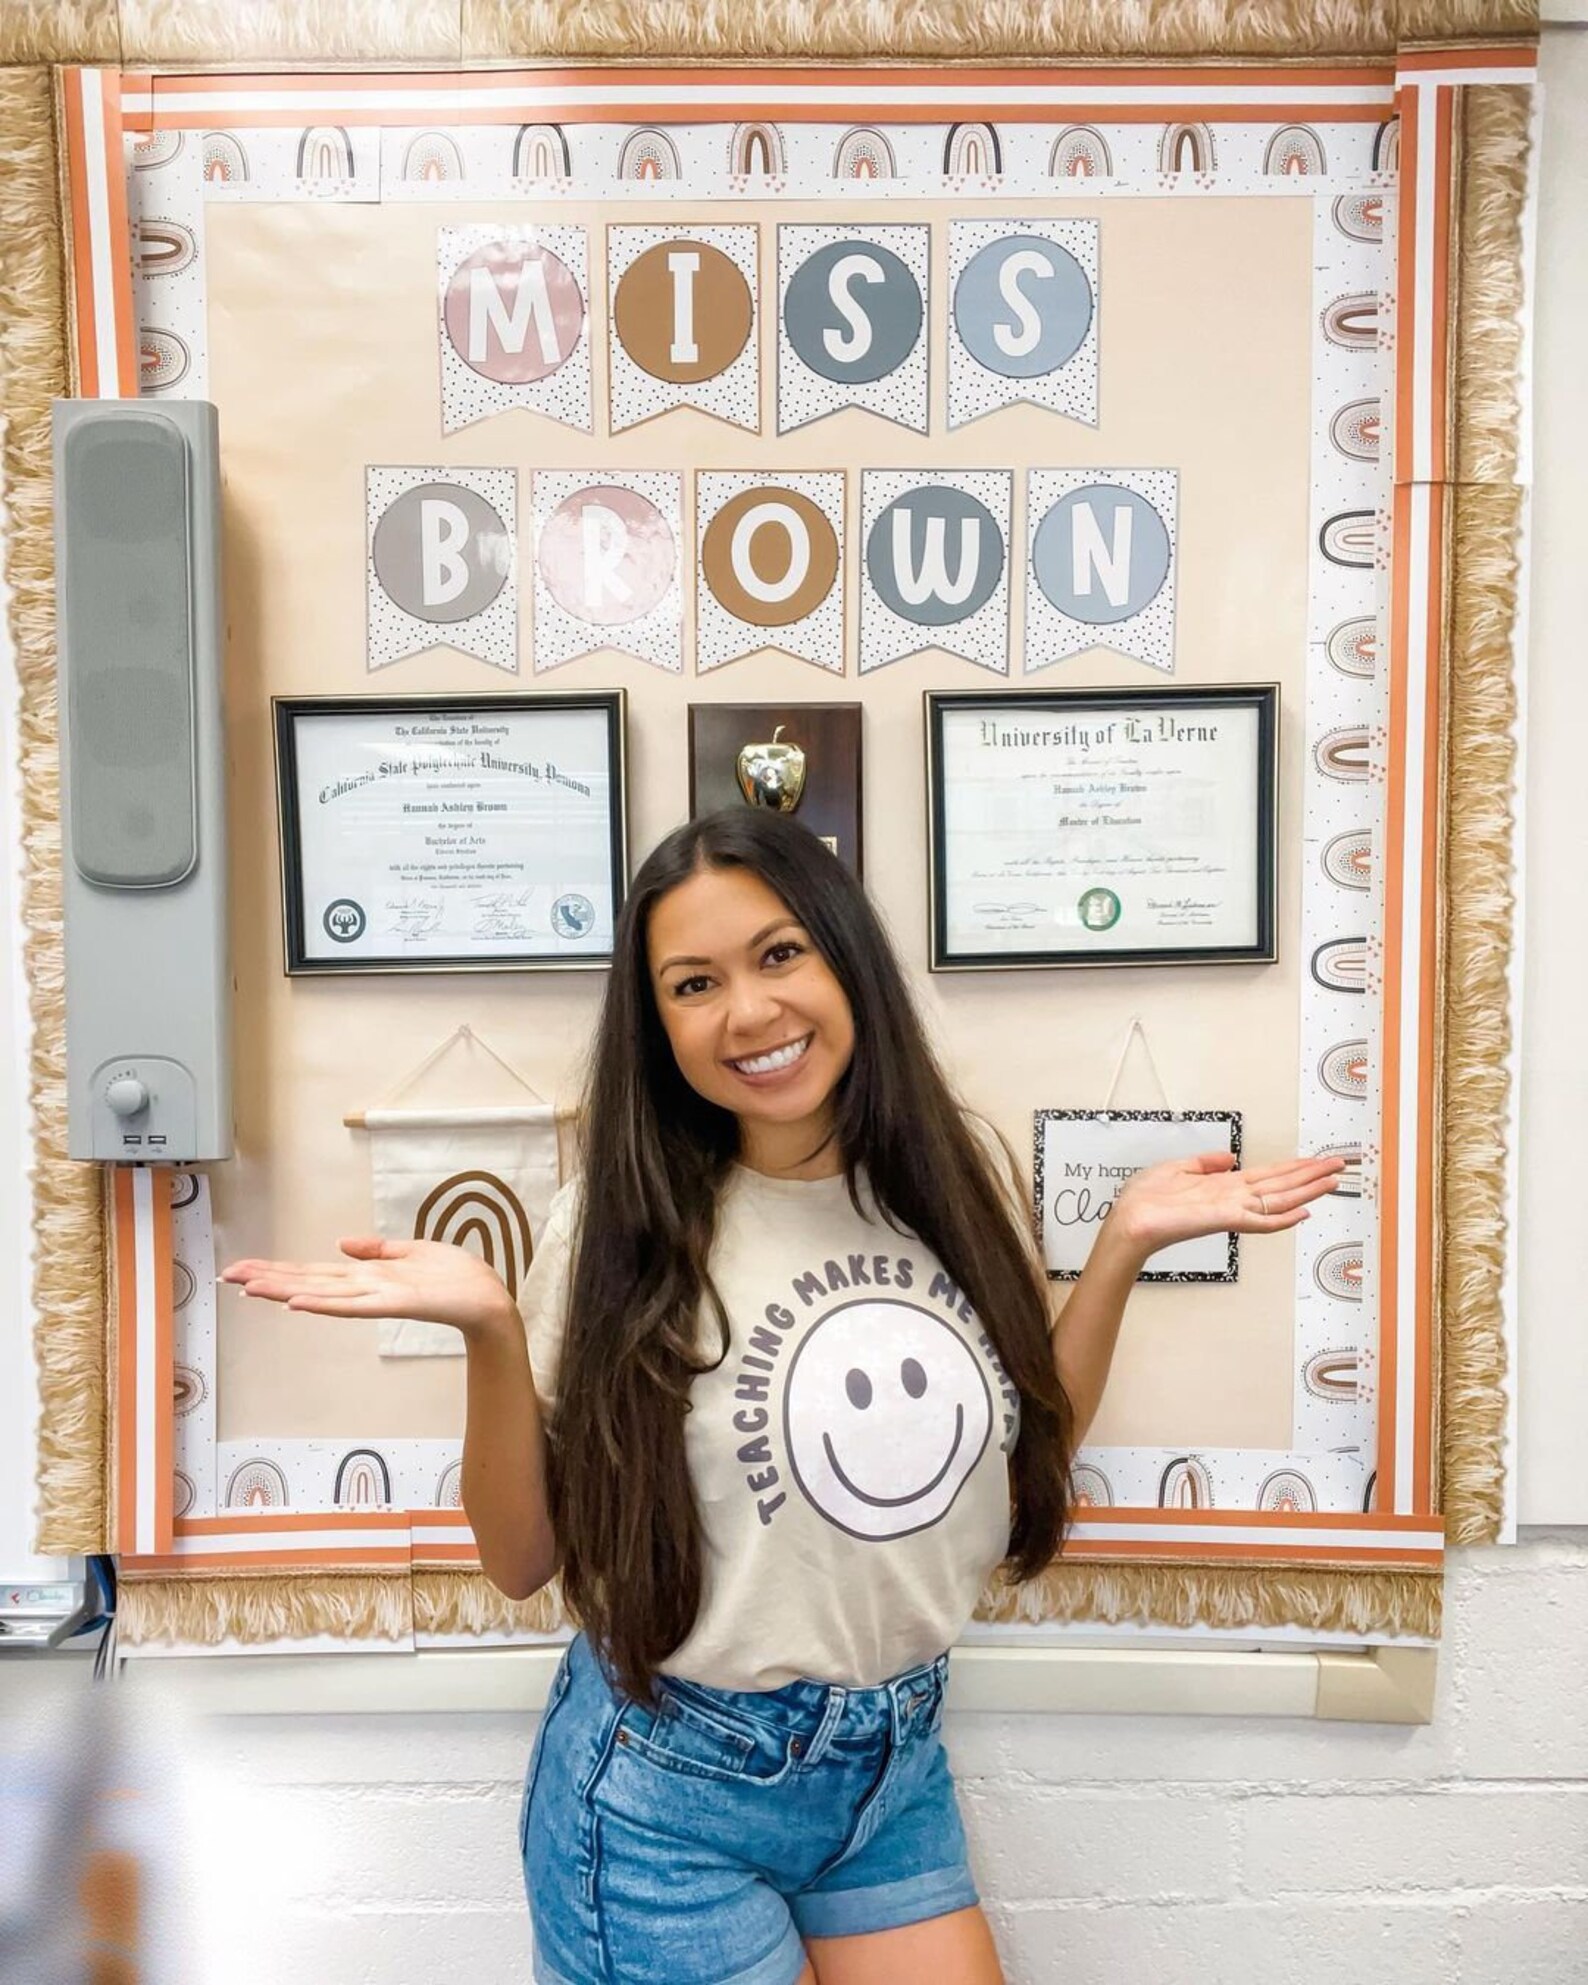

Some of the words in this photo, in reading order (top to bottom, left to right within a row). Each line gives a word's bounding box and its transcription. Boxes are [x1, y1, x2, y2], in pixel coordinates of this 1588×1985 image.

[468, 250, 1054, 365] MISS
[419, 499, 1134, 608] BROWN
[395, 727, 410, 735] The
[412, 726, 448, 735] California
[450, 726, 469, 734] State
[471, 725, 510, 736] University
[980, 720, 1090, 752] University
[1096, 722, 1117, 744] of
[1125, 717, 1153, 743] La
[1158, 716, 1218, 742] Verne
[379, 761, 408, 778] State
[402, 802, 439, 813] Hannah
[441, 802, 474, 813] Ashley
[476, 801, 508, 812] Brown
[469, 837, 486, 845] Arts
[1064, 1162, 1092, 1181] My
[1054, 1188, 1112, 1226] Cla
[733, 1303, 796, 1525] TEACHING
[792, 1254, 914, 1306] MAKES
